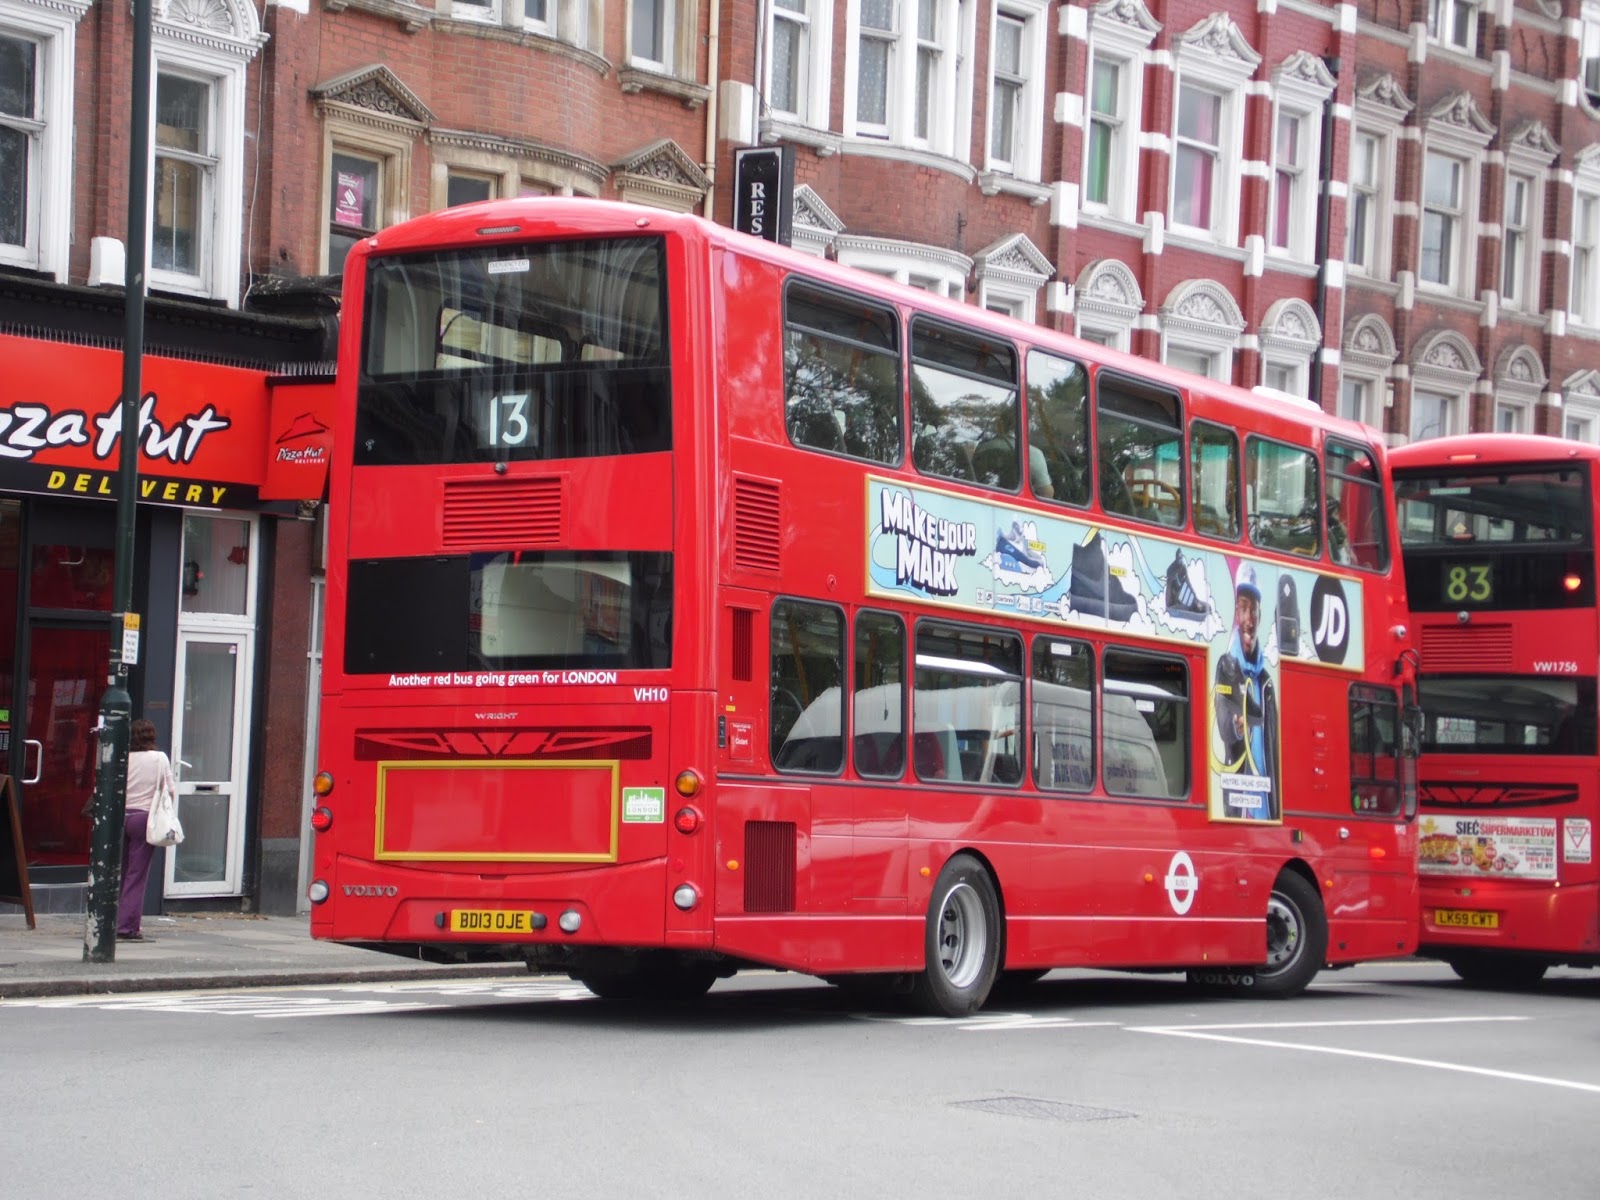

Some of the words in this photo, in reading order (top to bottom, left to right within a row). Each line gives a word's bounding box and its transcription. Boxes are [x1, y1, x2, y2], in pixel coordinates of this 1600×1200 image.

[750, 182, 766, 239] RES
[96, 396, 229, 461] Hut
[489, 394, 528, 446] 13
[276, 447, 302, 462] Pizza
[303, 446, 325, 458] Hut
[47, 470, 227, 504] DELVERY
[881, 487, 937, 547] MAKE
[937, 518, 977, 556] YOUR
[896, 533, 959, 597] MARK
[1448, 566, 1491, 600] 83
[1315, 594, 1346, 647] JD
[388, 674, 431, 686] Another
[434, 673, 450, 684] red
[454, 673, 473, 685] bus
[475, 672, 505, 687] going
[508, 673, 539, 687] green
[542, 672, 559, 684] for
[562, 672, 617, 684] LONDON
[1533, 662, 1578, 672] VW1756
[634, 688, 668, 701] VH10
[475, 712, 518, 720] WRIGHT
[342, 885, 398, 897] VOLVO
[460, 913, 492, 928] BD13
[496, 913, 524, 929] OJE
[1440, 912, 1469, 924] LK59
[1471, 913, 1494, 926] CWT
